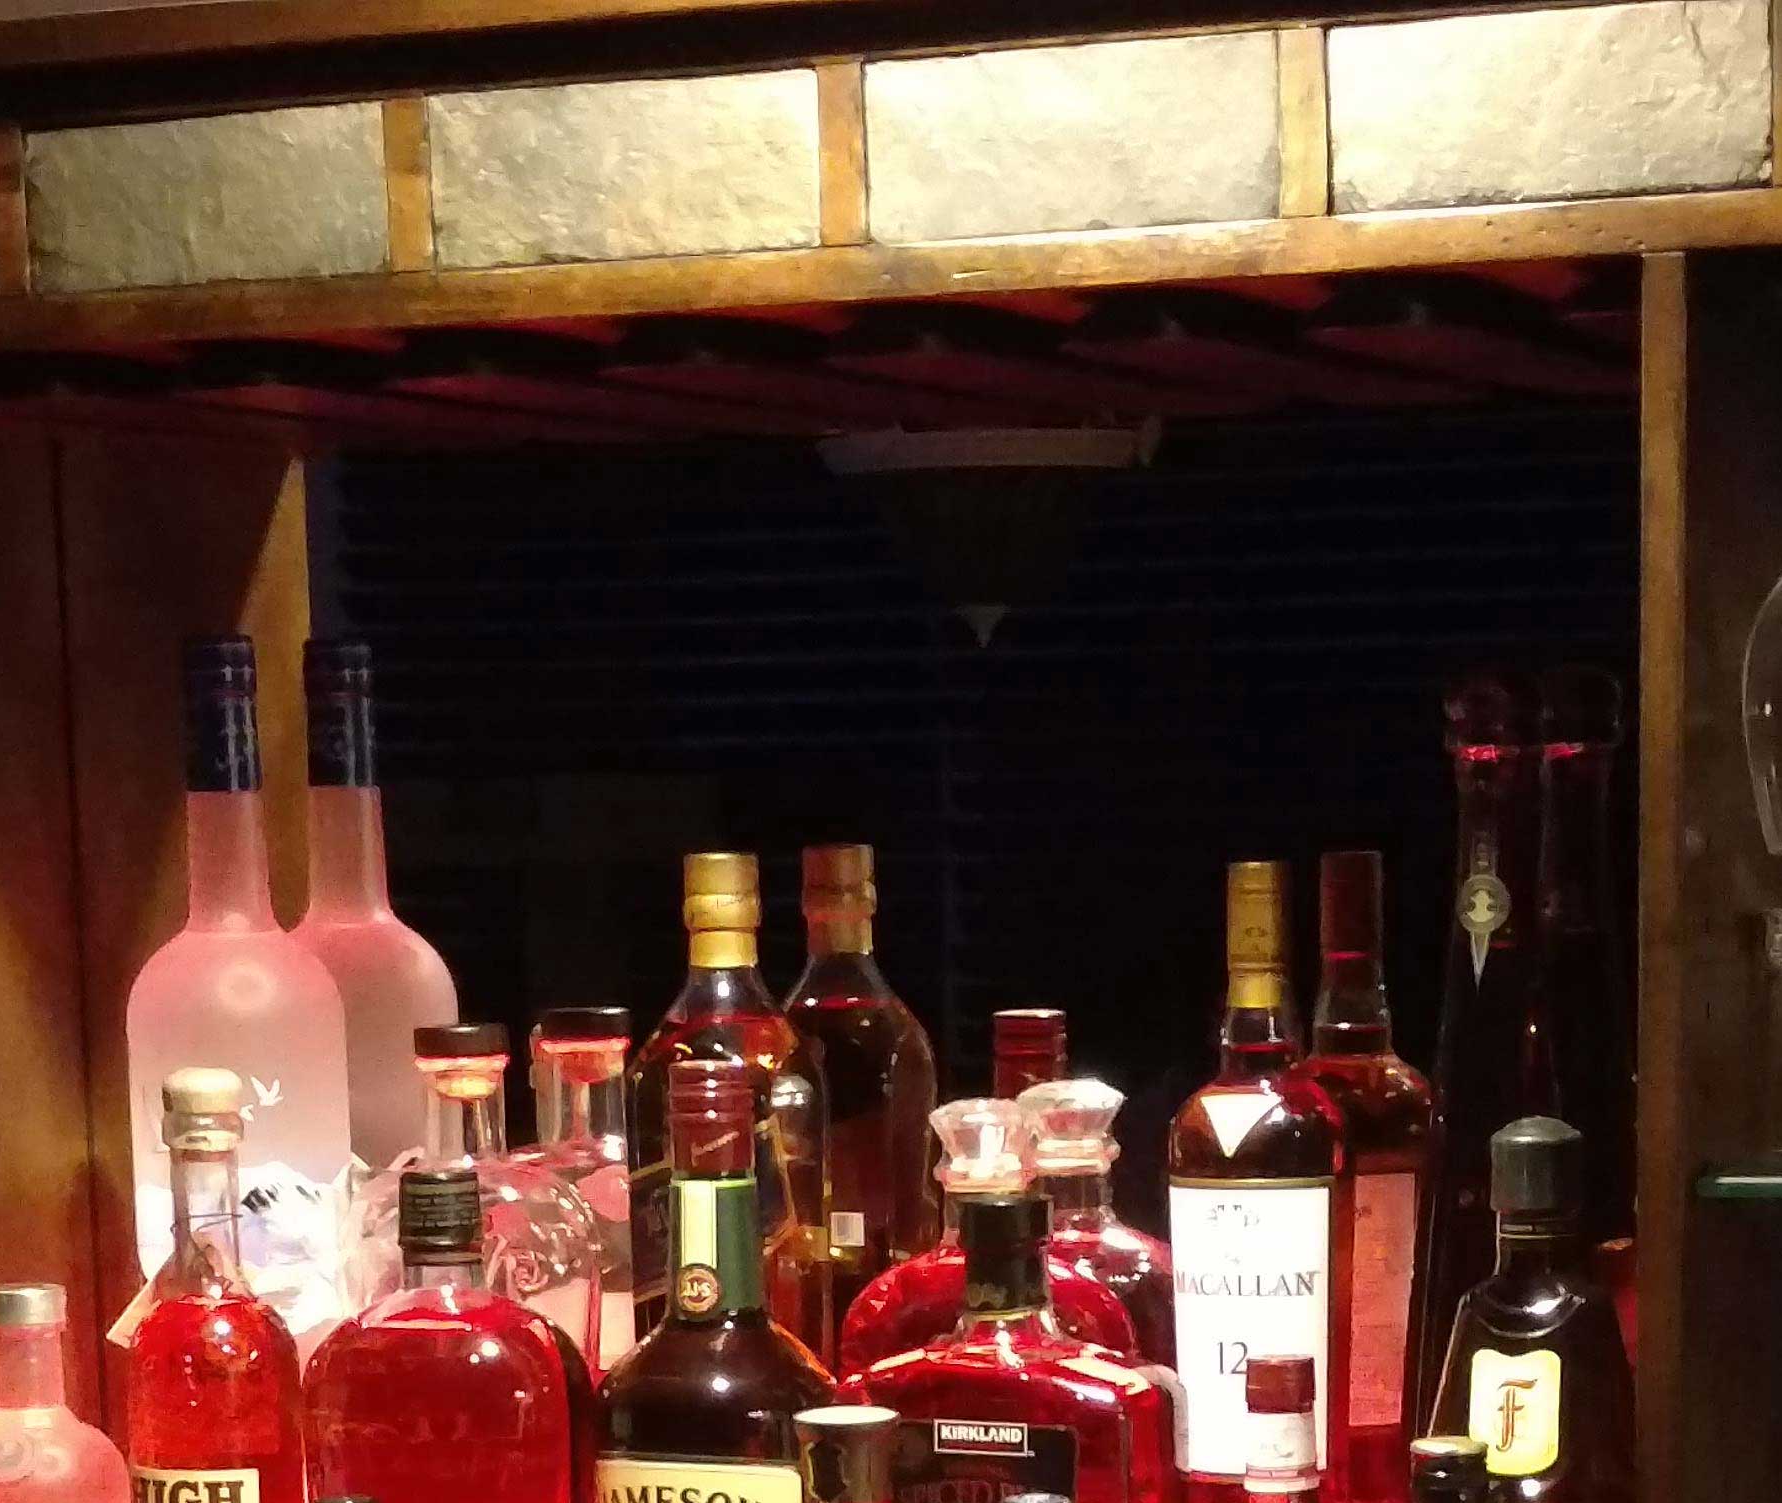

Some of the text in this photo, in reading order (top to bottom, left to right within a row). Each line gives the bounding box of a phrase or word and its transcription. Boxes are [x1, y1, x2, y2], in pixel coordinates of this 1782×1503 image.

[1175, 1270, 1321, 1298] MACALLAN
[1217, 1341, 1249, 1375] 12
[940, 1424, 1023, 1443] KIRKLAND
